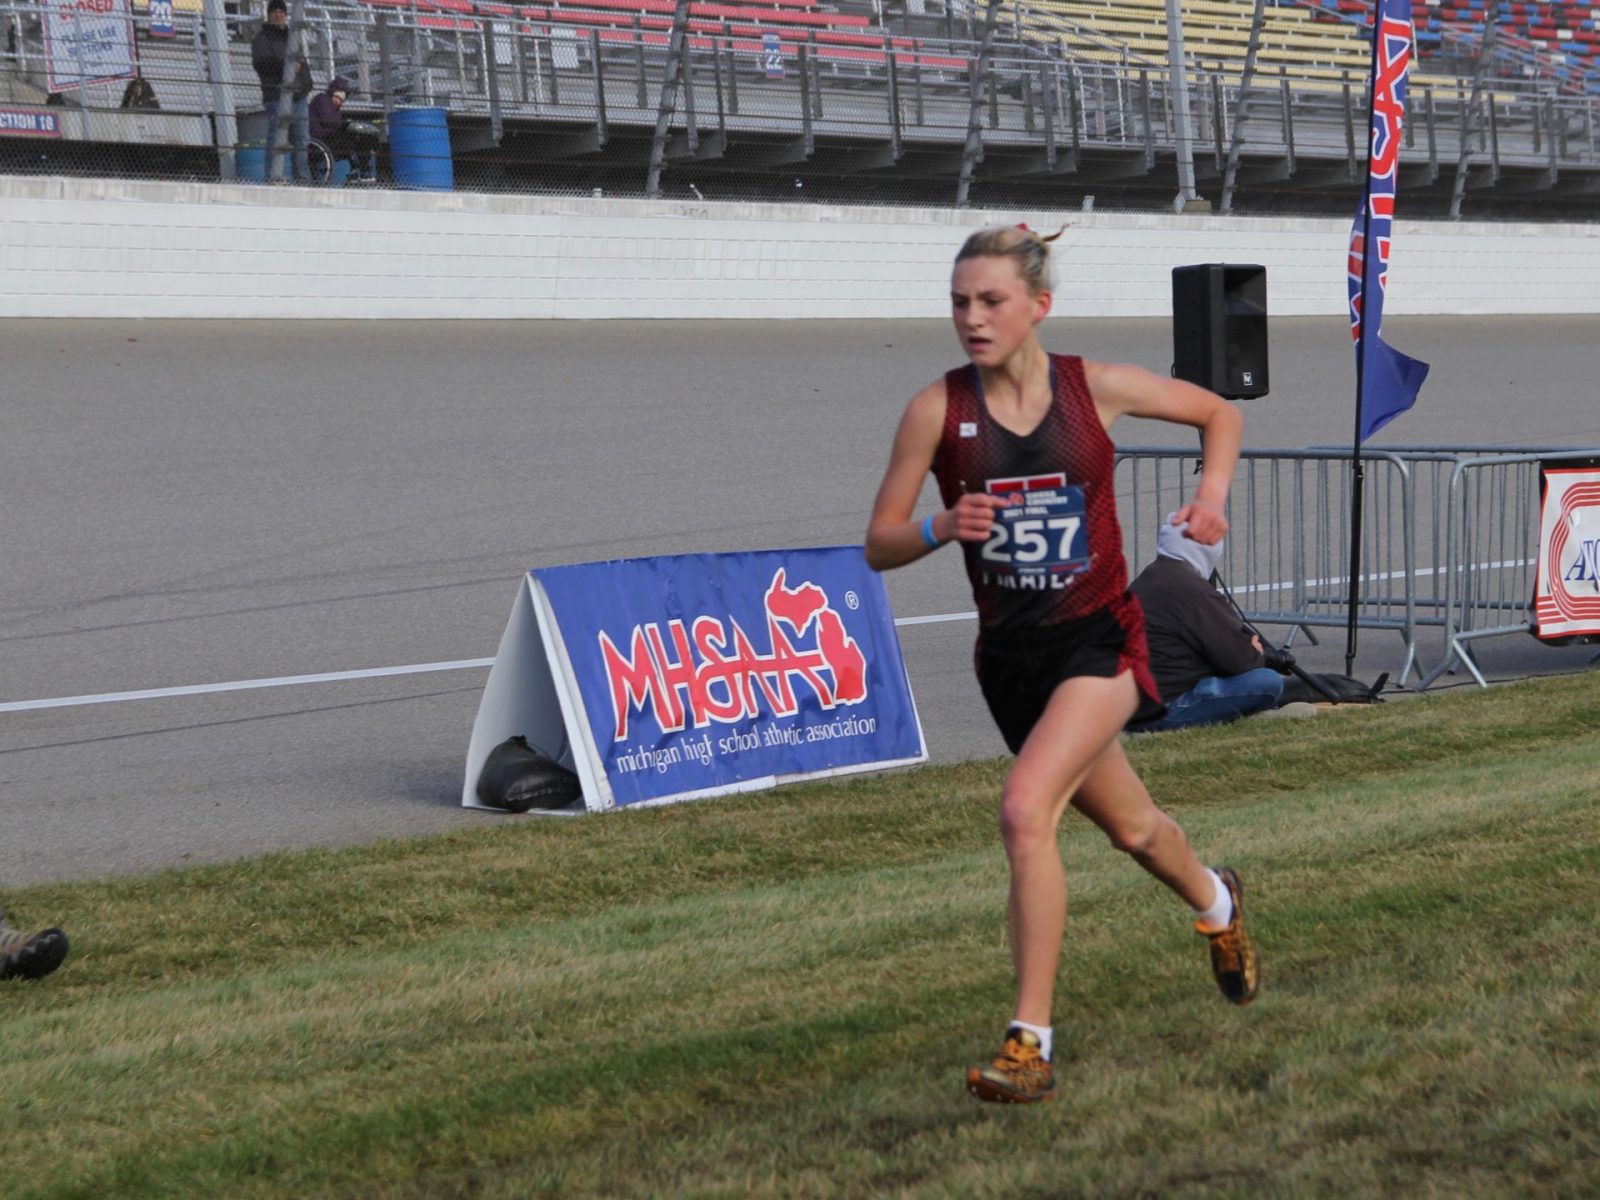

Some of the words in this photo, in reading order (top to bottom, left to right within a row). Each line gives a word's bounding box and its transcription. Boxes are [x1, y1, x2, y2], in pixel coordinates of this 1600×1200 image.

[150, 1, 173, 28] 20
[67, 40, 114, 57] SETIONS
[981, 516, 1081, 562] 257
[598, 610, 837, 743] MHSAA
[617, 744, 682, 774] michigan
[719, 724, 762, 755] school
[805, 714, 876, 743] association
